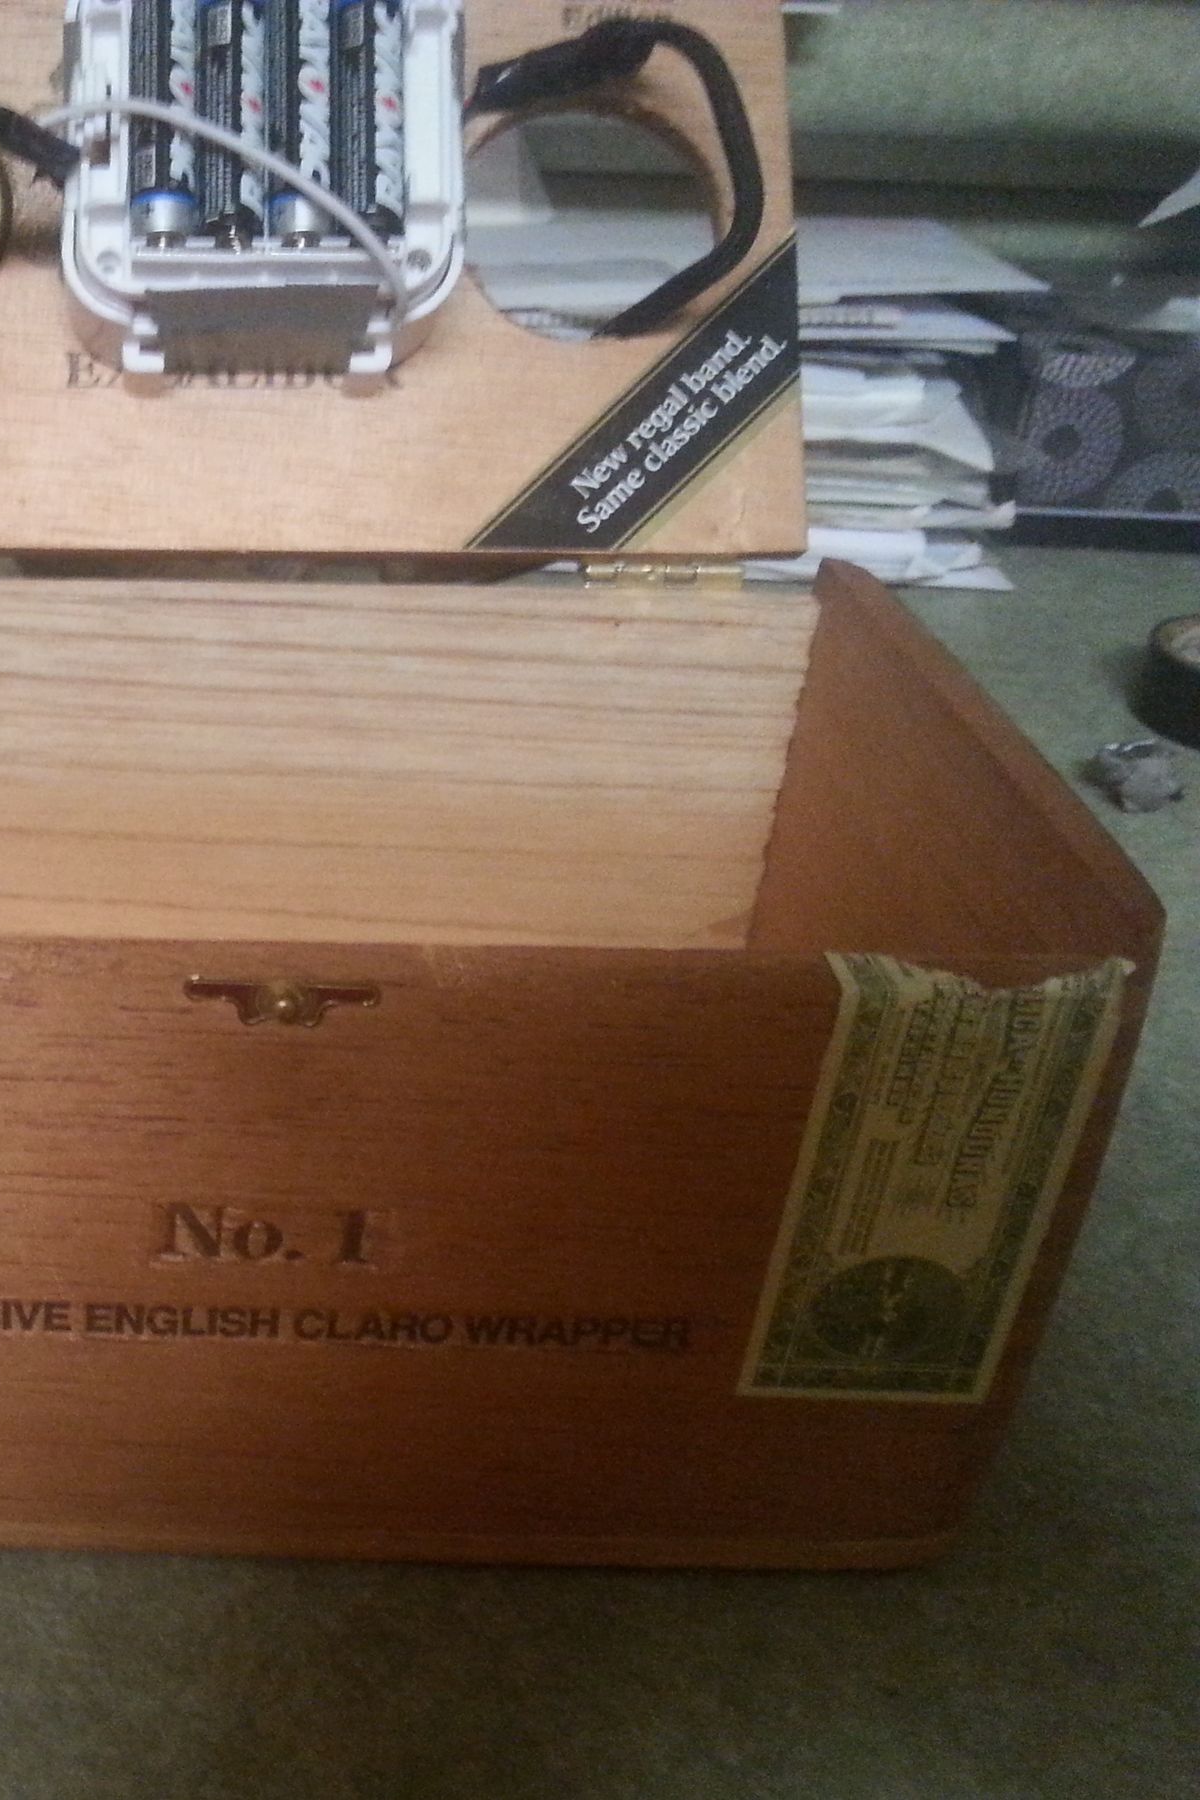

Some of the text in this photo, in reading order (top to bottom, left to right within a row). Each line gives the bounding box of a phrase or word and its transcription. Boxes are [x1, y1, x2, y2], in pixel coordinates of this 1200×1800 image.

[569, 329, 752, 500] New regal band.
[576, 333, 788, 533] Same classic blend.
[158, 1202, 304, 1262] No.
[85, 1303, 279, 1339] ENGLISH
[293, 1307, 454, 1344] CLARO
[465, 1313, 692, 1350] WRAPPER
